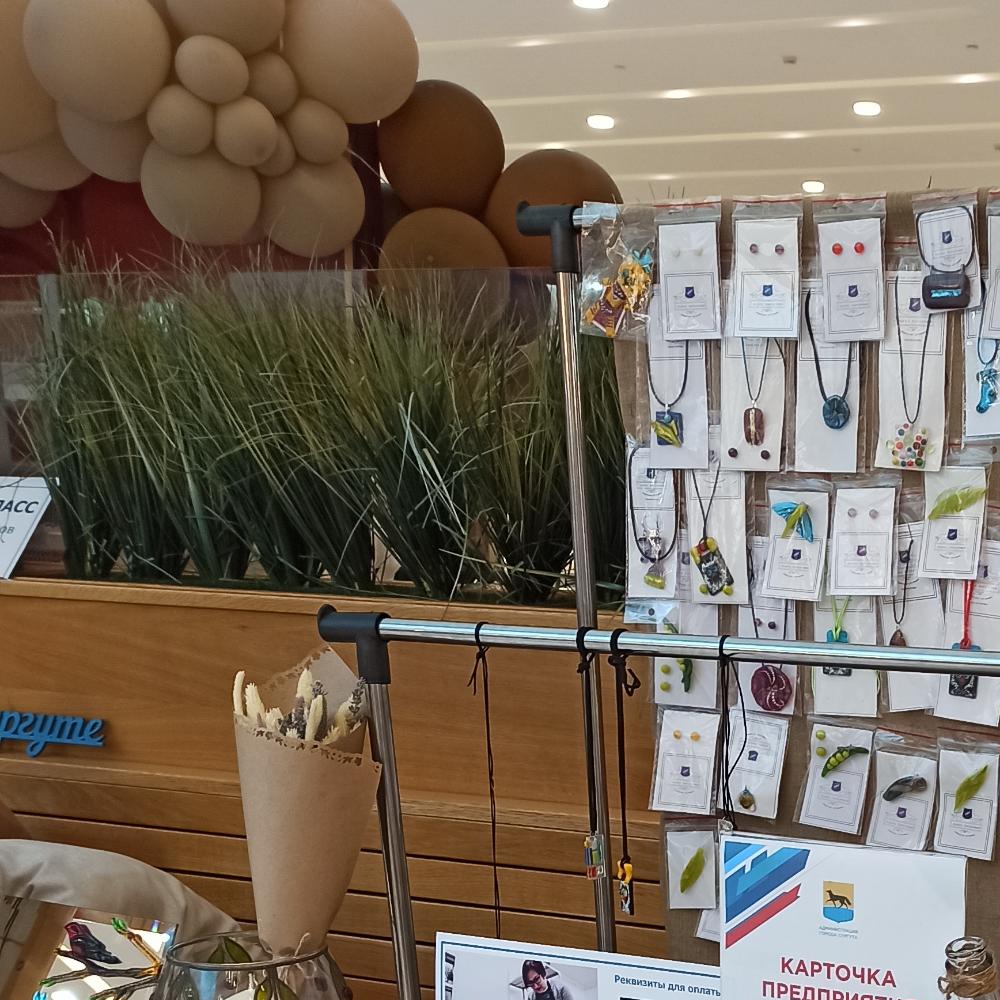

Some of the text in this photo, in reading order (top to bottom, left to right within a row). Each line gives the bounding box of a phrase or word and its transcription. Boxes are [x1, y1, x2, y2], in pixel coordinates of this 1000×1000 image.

[614, 974, 665, 989] Реквизиты
[668, 983, 686, 992] для
[780, 956, 897, 988] КАРТОЧКА
